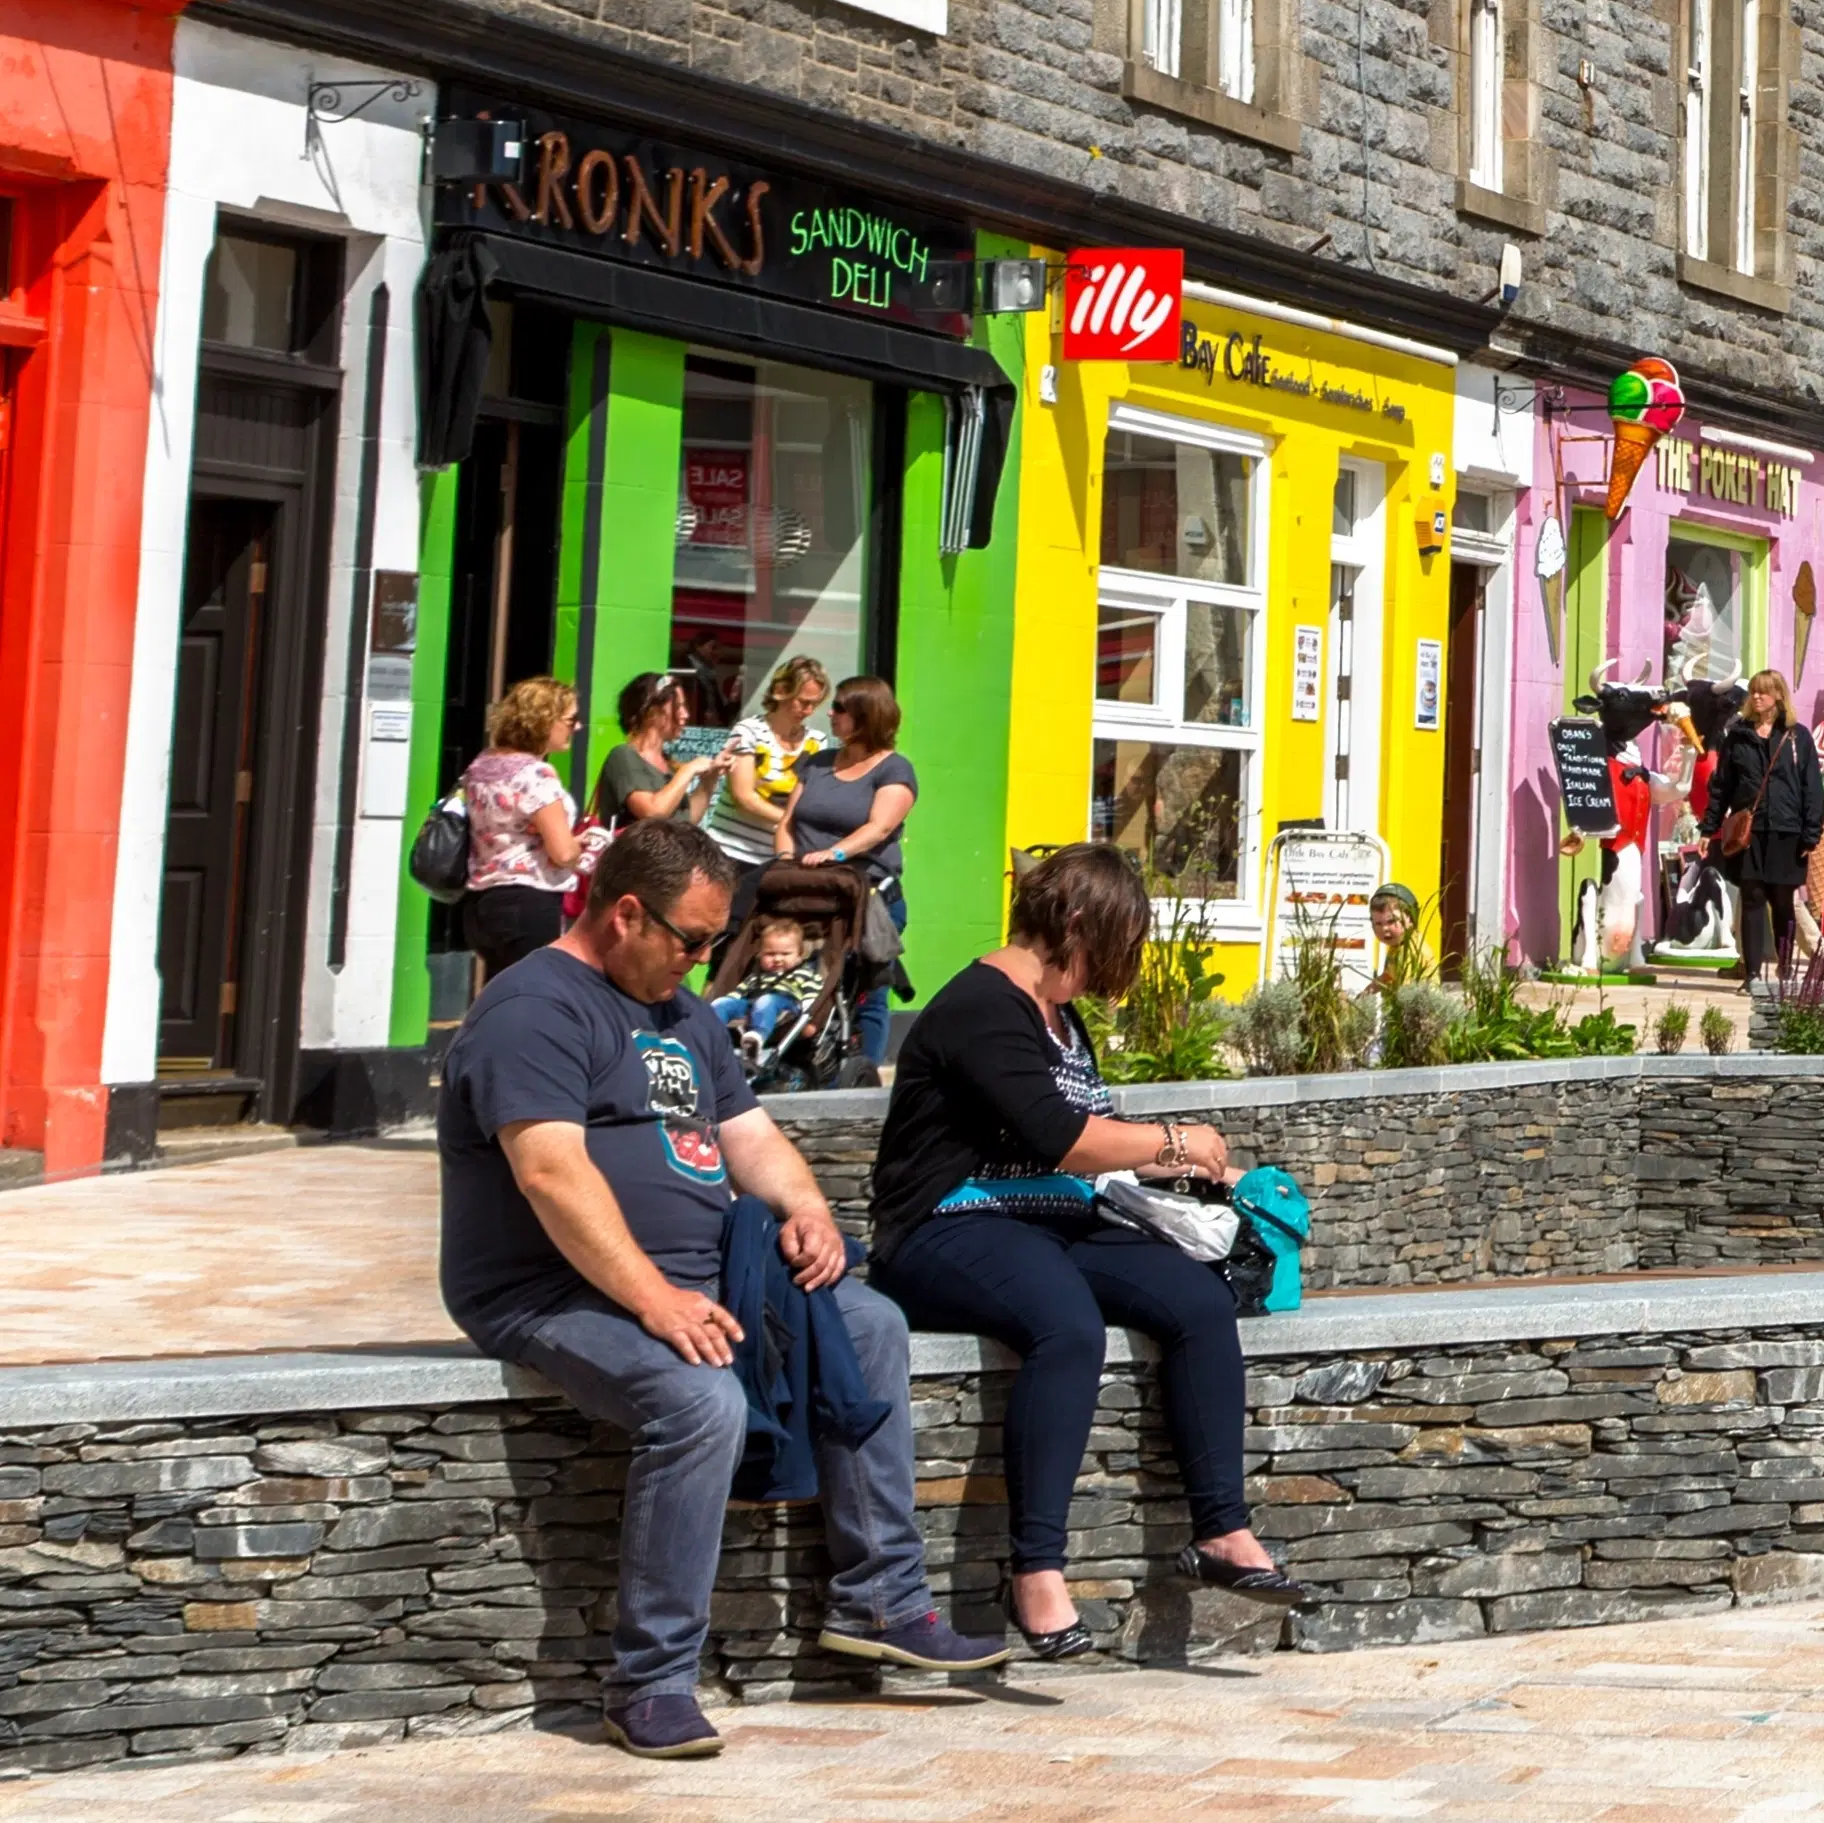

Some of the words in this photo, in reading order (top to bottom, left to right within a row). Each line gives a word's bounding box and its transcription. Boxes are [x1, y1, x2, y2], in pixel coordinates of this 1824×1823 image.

[790, 208, 929, 283] SANDWICH
[831, 257, 891, 310] DELI
[1070, 262, 1174, 353] illy
[1654, 434, 1693, 494] THE
[1700, 443, 1760, 506] POKEY
[1766, 460, 1802, 522] HAT
[1557, 742, 1577, 753] ONLY
[1561, 729, 1592, 740] OBAN'S
[1565, 778, 1597, 792] ITALIAN
[1567, 794, 1583, 807] ICE
[1585, 794, 1612, 808] CREAM
